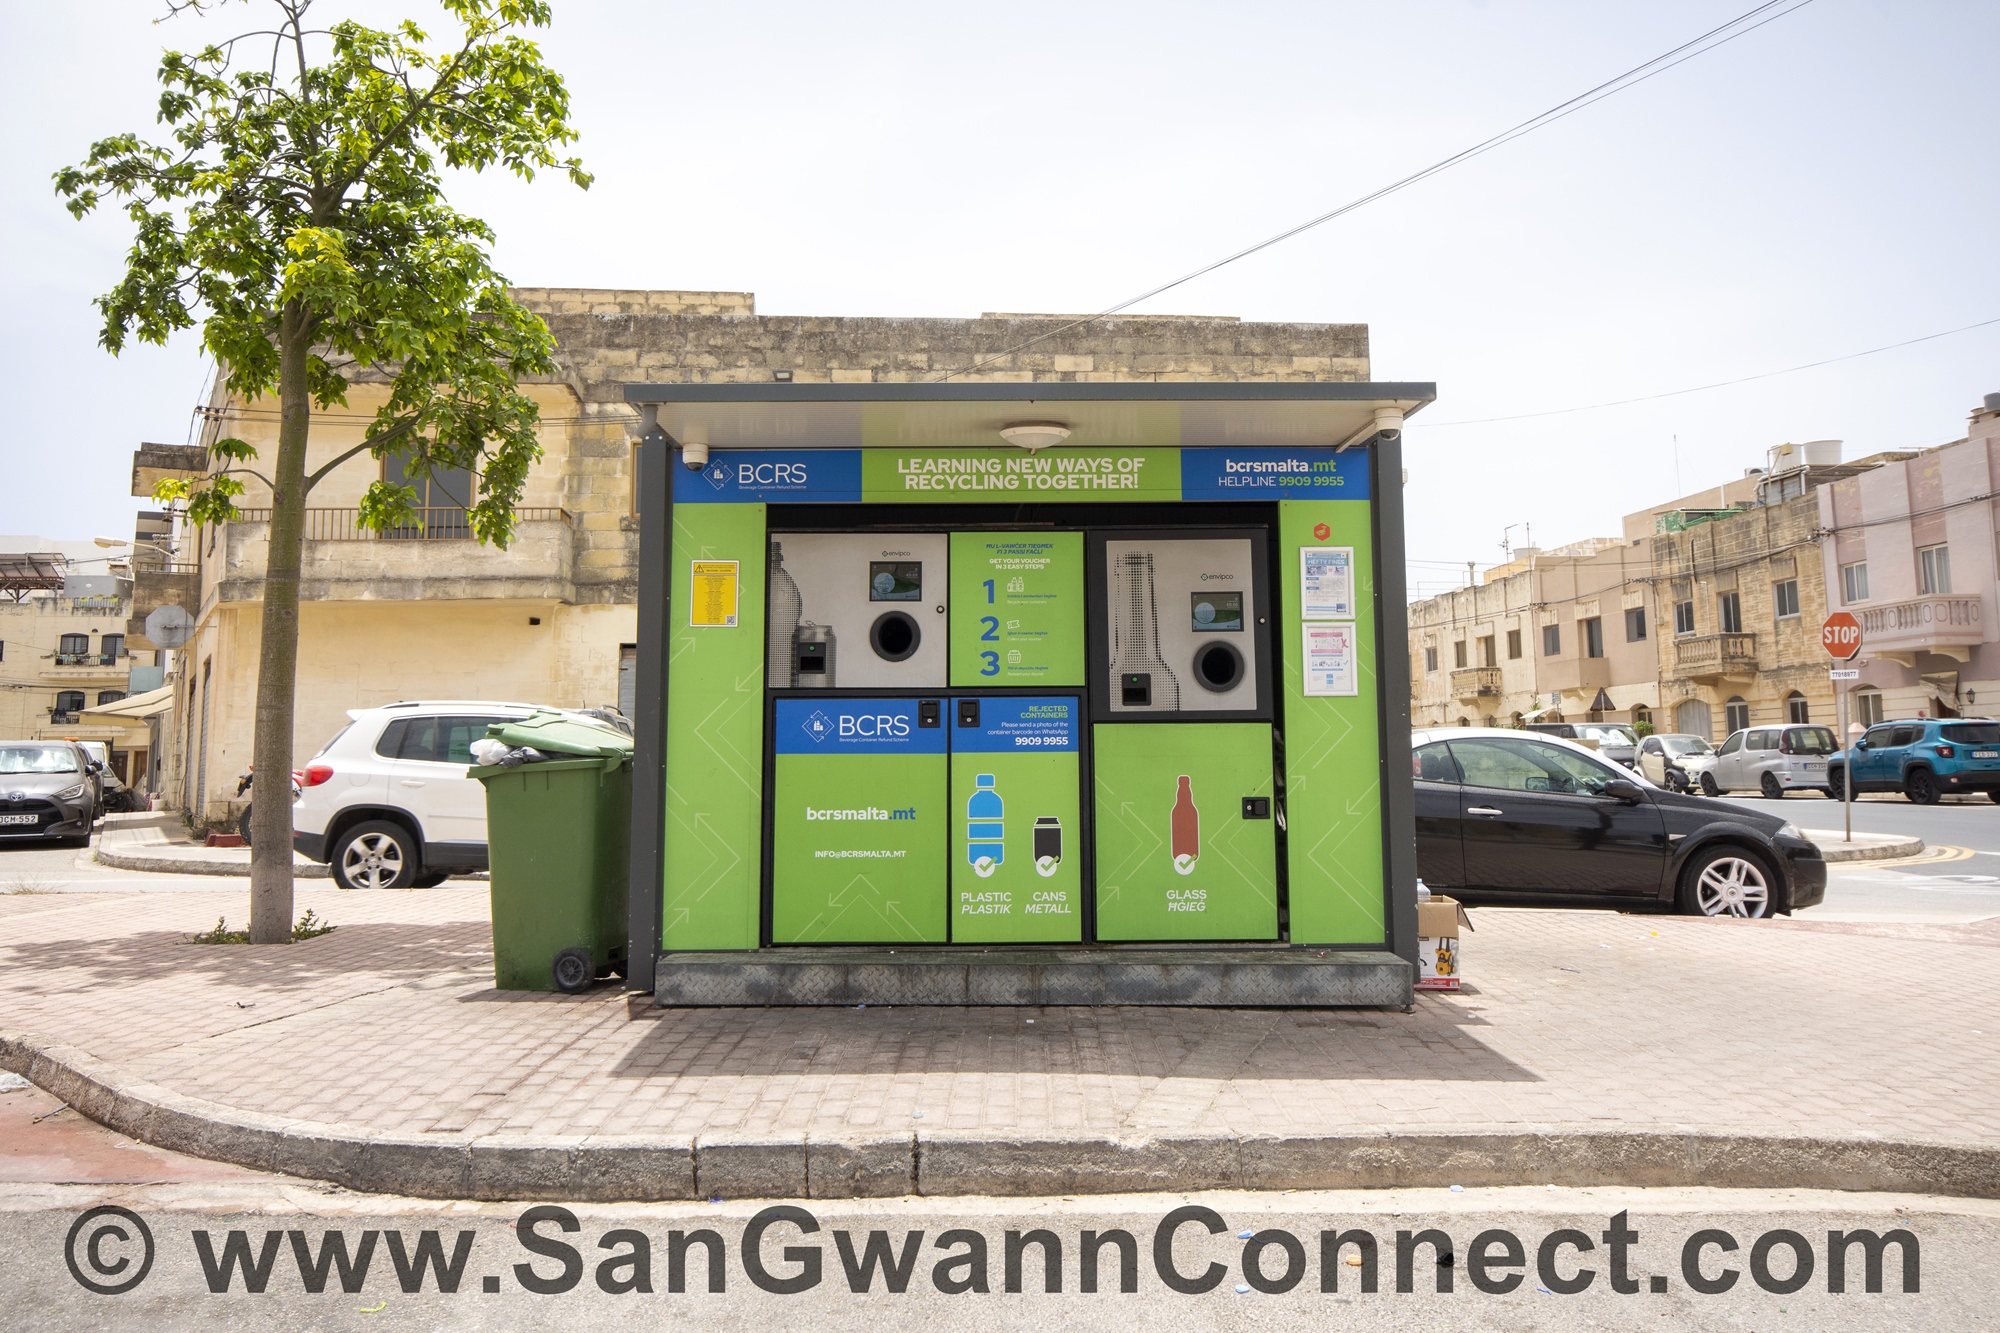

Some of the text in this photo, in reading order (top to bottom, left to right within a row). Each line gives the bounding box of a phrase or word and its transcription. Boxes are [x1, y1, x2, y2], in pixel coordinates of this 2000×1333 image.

[898, 457, 1145, 474] LEARNING NEW WAYS OF
[1225, 458, 1337, 473] bcrsmalta.mt
[738, 463, 807, 484] BCRS
[904, 474, 1139, 490] RECYCLING TOGETHER!
[1218, 475, 1345, 487] HELPLINE 9909 9955
[982, 579, 995, 604] 1
[980, 616, 1000, 641] 2
[1824, 626, 1859, 644] STOP
[980, 651, 1000, 676] 3
[839, 715, 910, 736] BCRS
[1015, 737, 1069, 746] 9909 9955
[806, 807, 916, 821] bcrsmalta.mt
[815, 850, 906, 858] INFO@BCRSMALTA.MT
[961, 892, 1012, 902] PLASTIC
[1032, 892, 1067, 902] CANS
[1166, 889, 1207, 900] GLASS
[961, 904, 1012, 914] PLASTIK
[1025, 904, 1071, 914] METALL
